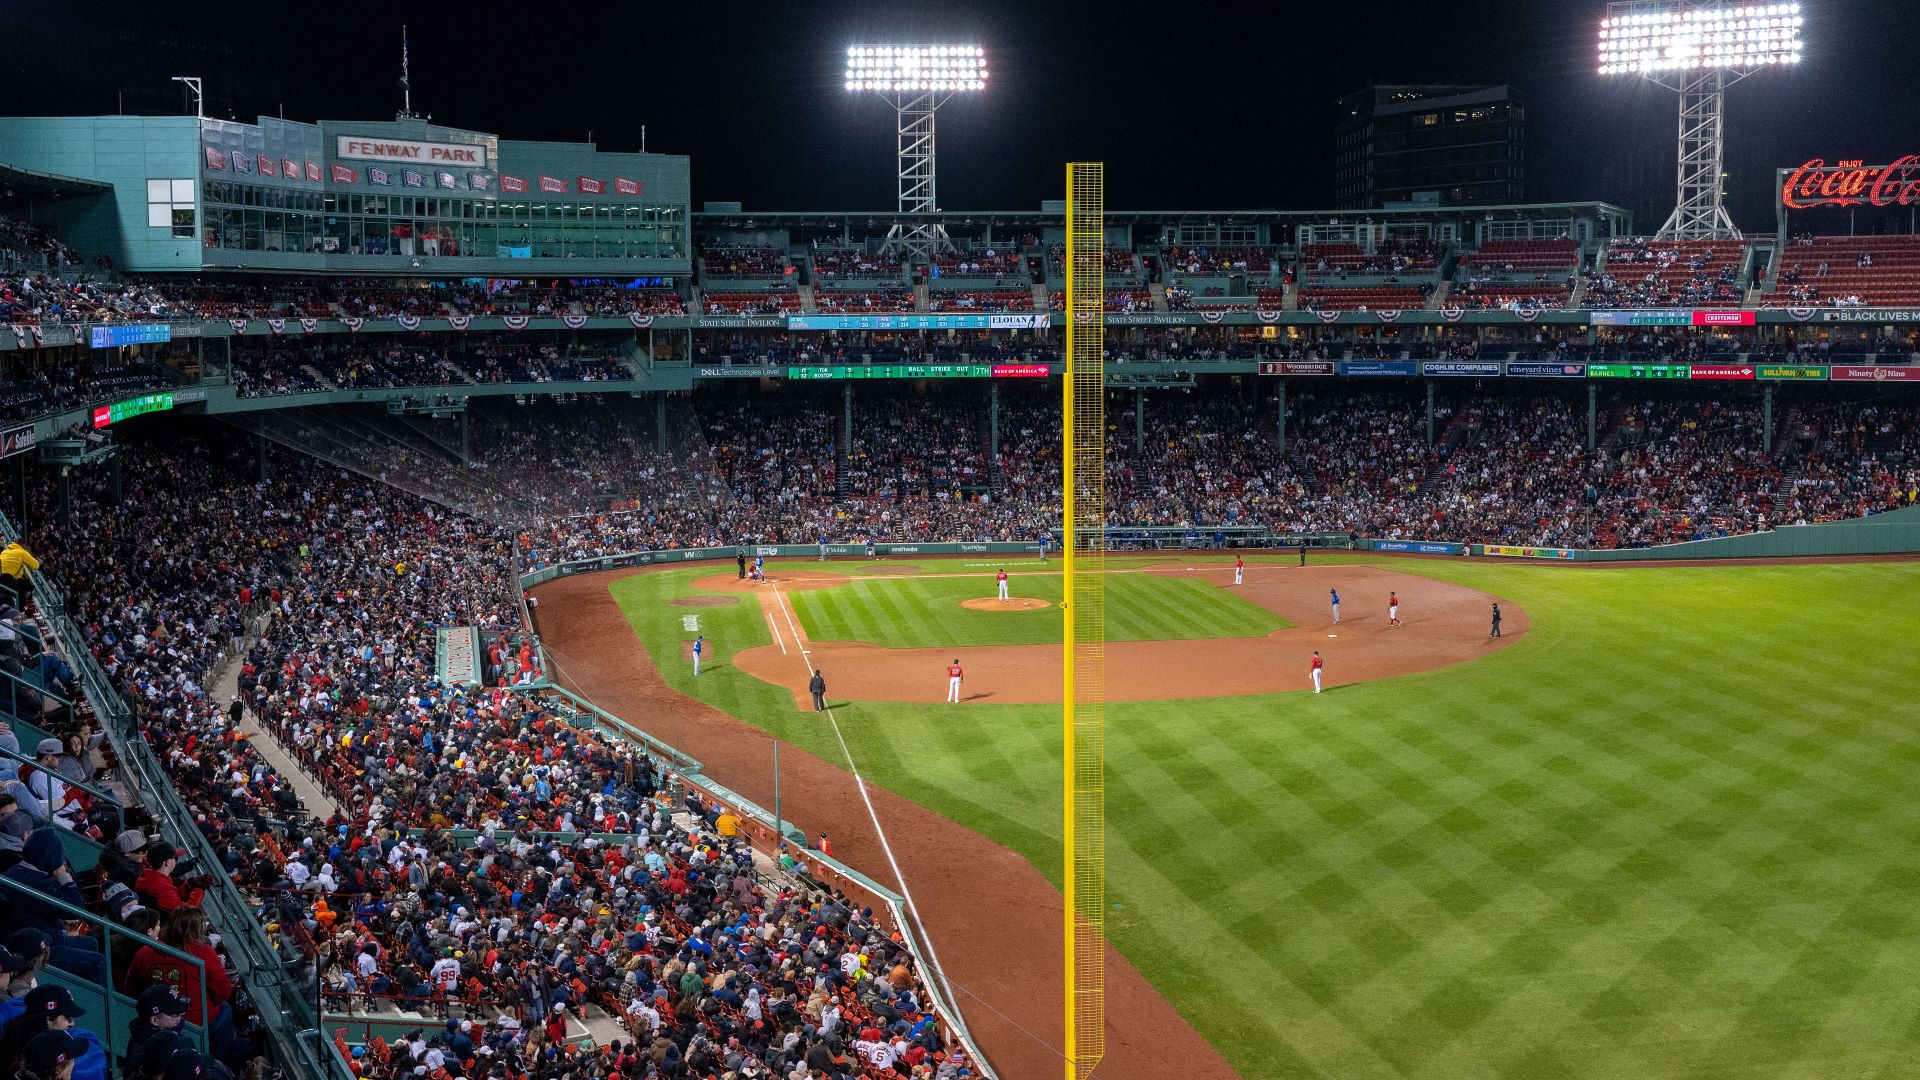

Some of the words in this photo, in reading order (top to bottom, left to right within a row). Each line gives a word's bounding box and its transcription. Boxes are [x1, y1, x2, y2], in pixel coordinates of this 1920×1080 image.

[348, 141, 421, 159] FENWAY
[431, 147, 476, 162] PARK
[1839, 159, 1863, 168] ENJOY
[1782, 154, 1920, 209] Coca-Co
[992, 316, 1027, 324] ELOUAN
[1153, 315, 1186, 323] PAVILION
[1841, 312, 1878, 320] BLACK
[1879, 312, 1909, 320] LIVES
[720, 368, 762, 377] Technologies
[762, 368, 780, 376] Level
[1509, 366, 1542, 374] vineyard
[1849, 369, 1873, 378] Ninety
[841, 960, 849, 970] 2
[441, 970, 455, 981] 99
[876, 1051, 884, 1062] 5
